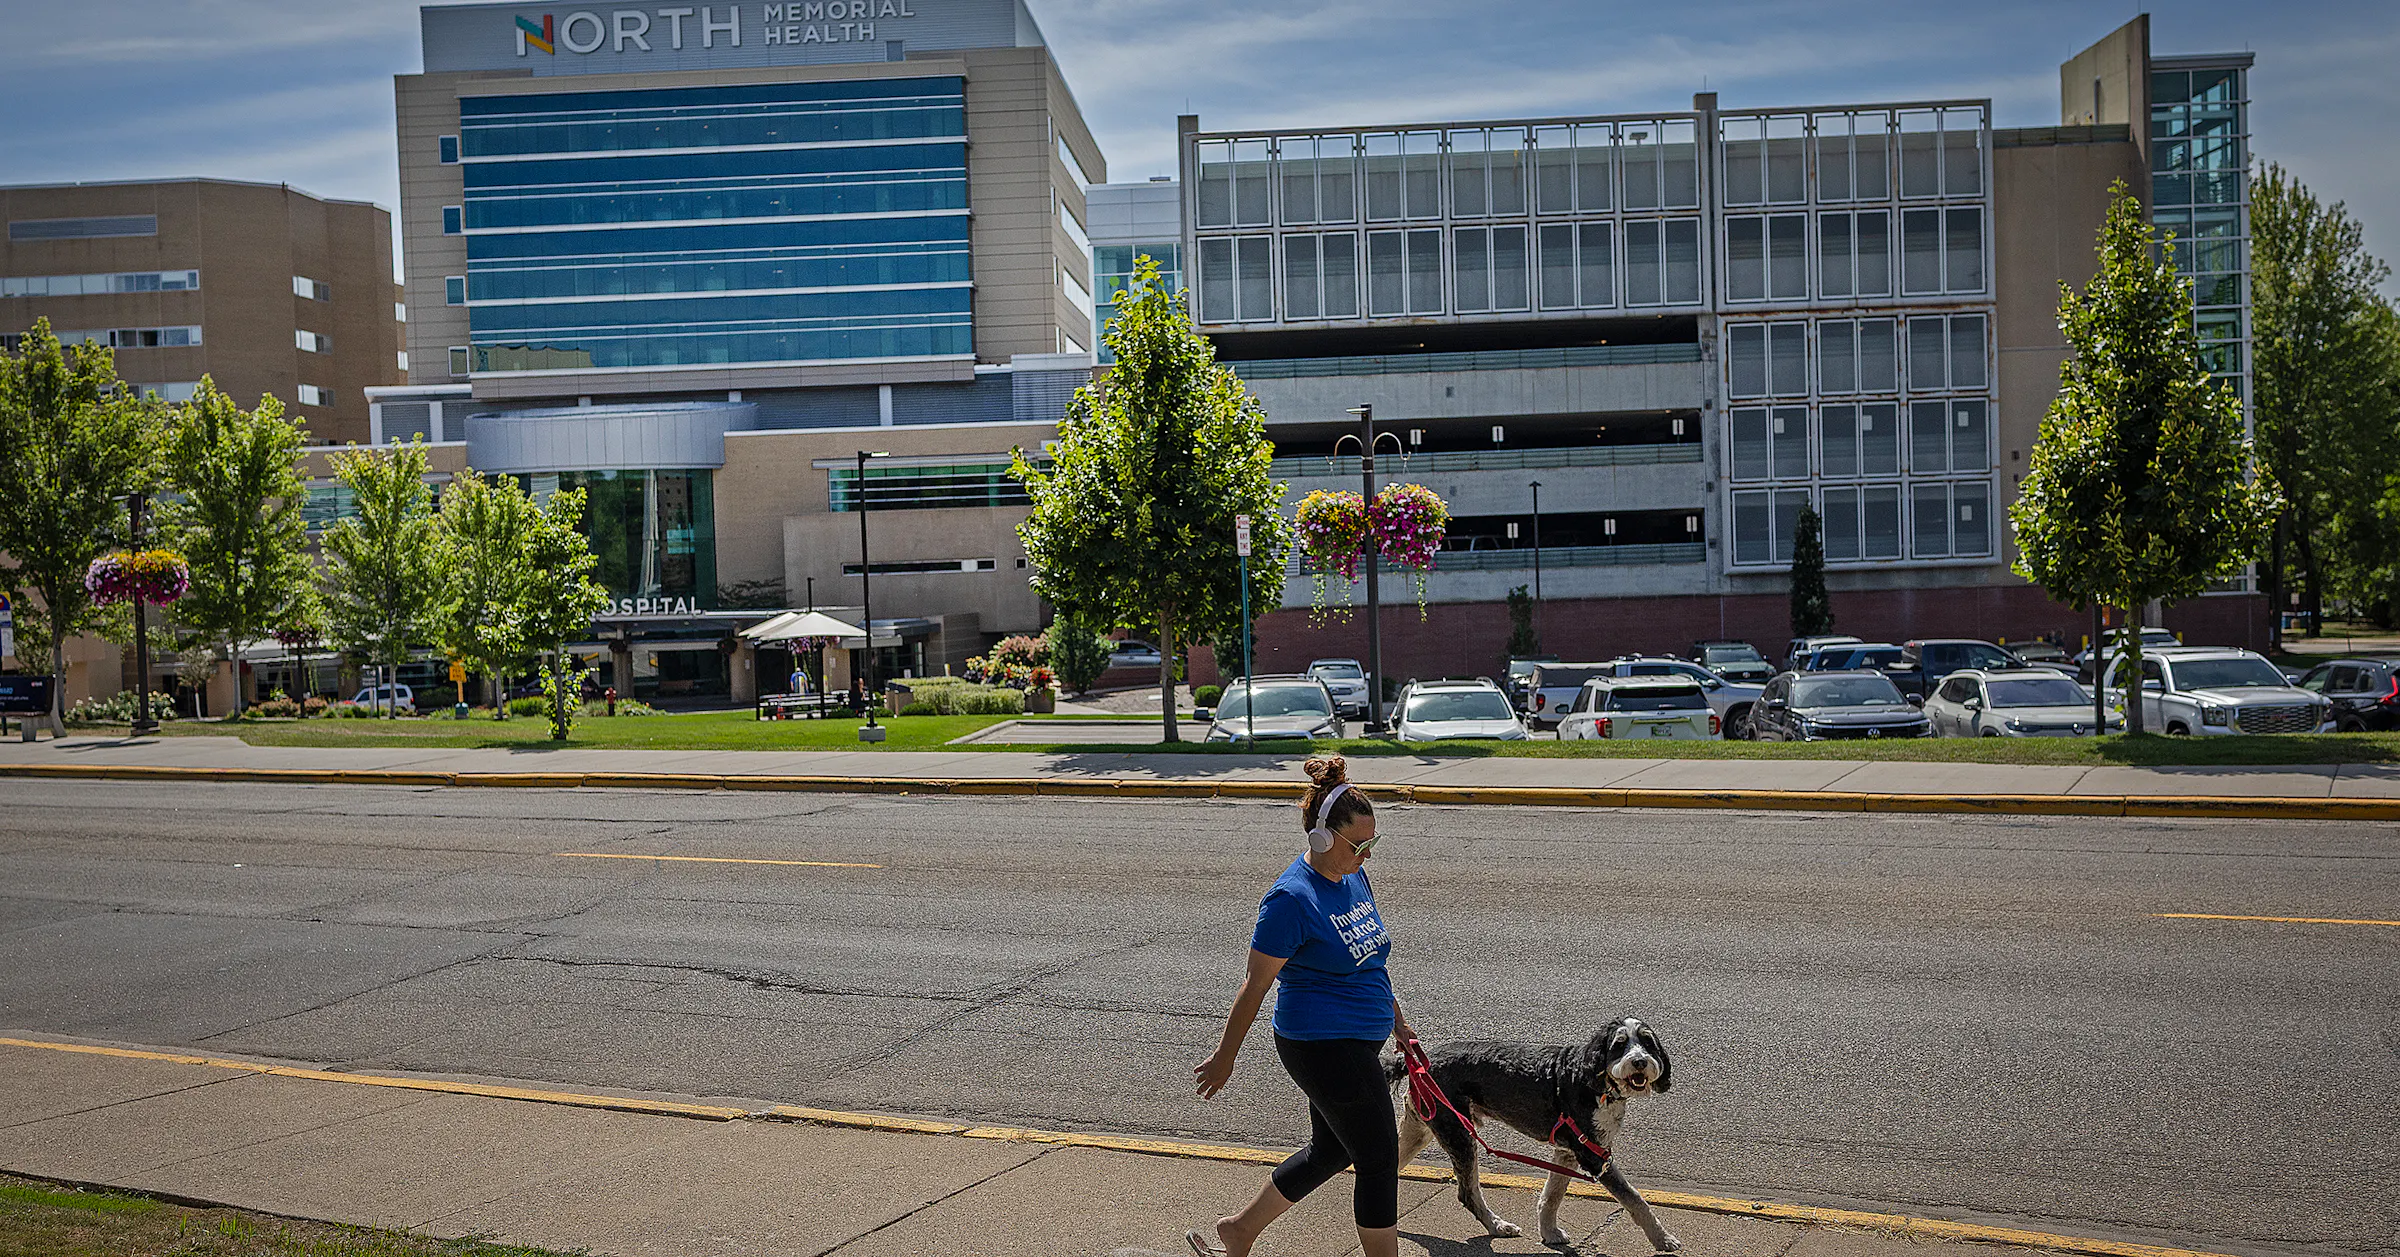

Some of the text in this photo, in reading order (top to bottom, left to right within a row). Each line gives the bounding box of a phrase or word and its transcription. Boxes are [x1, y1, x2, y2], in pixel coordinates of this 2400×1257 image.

[764, 0, 915, 21] MEMORIAL
[515, 5, 742, 56] NORTH
[764, 22, 877, 46] HEALTH
[591, 596, 702, 617] OSPITAL
[1329, 901, 1375, 930] I'm white
[1338, 916, 1380, 946] but not
[1348, 936, 1378, 960] that
